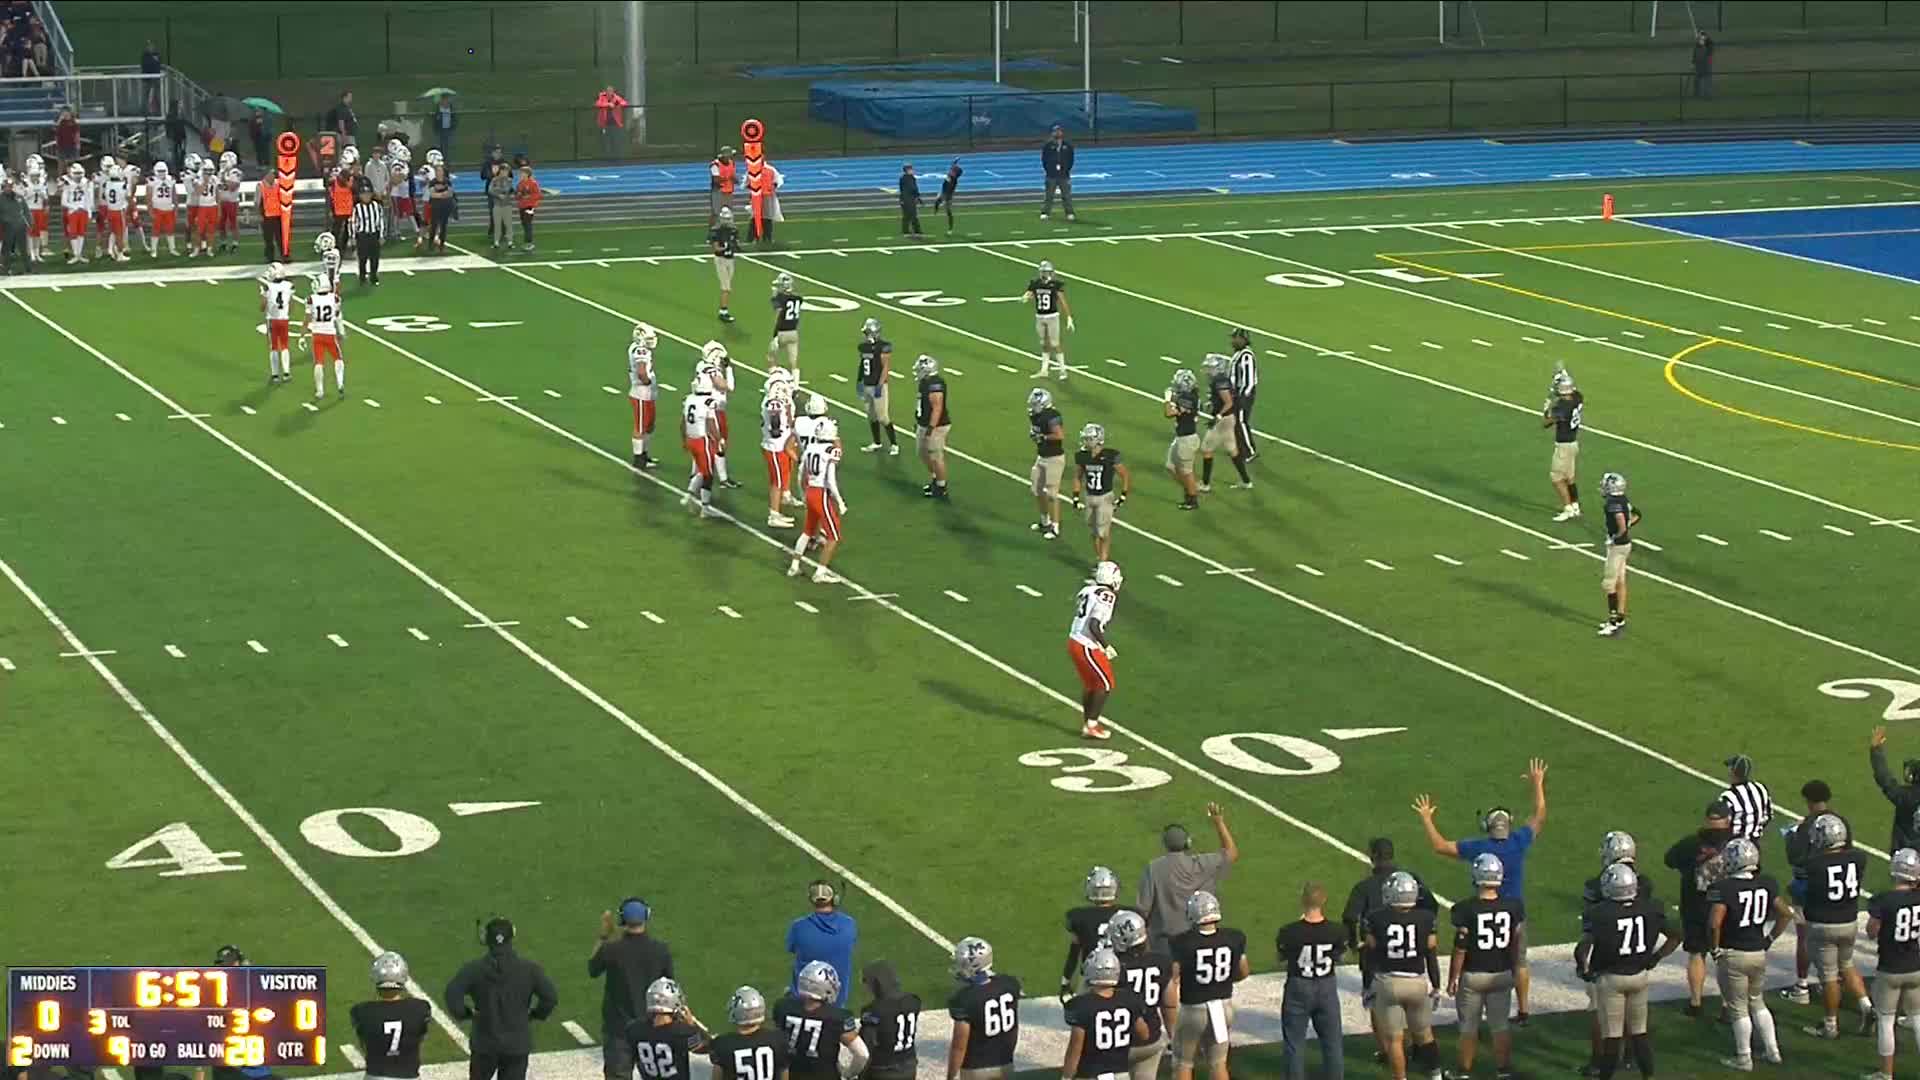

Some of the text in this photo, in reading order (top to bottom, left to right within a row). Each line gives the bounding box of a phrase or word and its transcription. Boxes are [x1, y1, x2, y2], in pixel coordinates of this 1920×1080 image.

[320, 137, 335, 154] 2
[108, 189, 117, 204] 9
[276, 291, 284, 310] 4
[315, 305, 332, 322] 12
[1036, 294, 1051, 310] 19
[863, 358, 871, 376] 9
[687, 404, 697, 424] 6
[807, 452, 820, 477] 10
[1087, 472, 1103, 491] 31
[1827, 862, 1859, 901] 54
[1738, 888, 1769, 928] 70
[1893, 904, 1920, 942] 85
[1386, 923, 1417, 960] 21
[1477, 911, 1511, 950] 53
[1616, 915, 1647, 955] 71
[1195, 946, 1232, 985] 58
[1297, 943, 1333, 979] 45
[1126, 966, 1161, 1006] 76
[894, 1012, 916, 1051] 11
[984, 992, 1015, 1037] 66
[1095, 1007, 1131, 1050] 62
[383, 1020, 403, 1056] 7
[785, 1015, 823, 1058] 77
[637, 1041, 678, 1078] 82
[734, 1046, 775, 1080] 50
